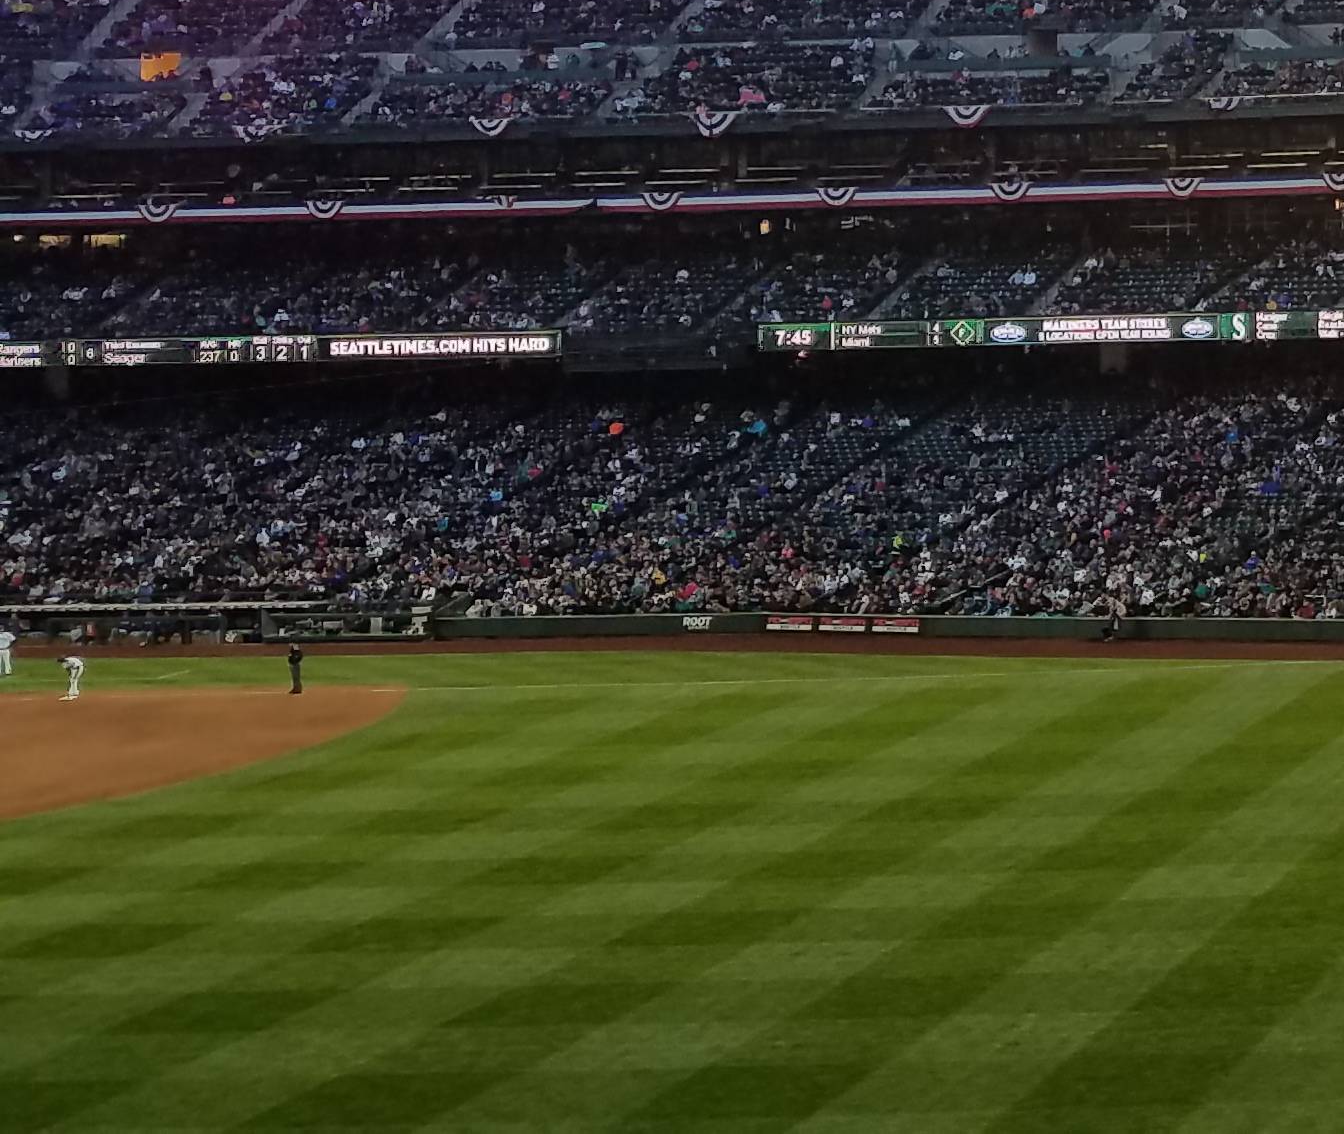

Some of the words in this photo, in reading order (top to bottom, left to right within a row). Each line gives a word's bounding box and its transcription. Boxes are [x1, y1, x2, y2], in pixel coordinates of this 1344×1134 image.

[775, 329, 813, 346] 7:45
[842, 325, 857, 335] NY
[255, 346, 265, 361] 3
[276, 346, 287, 361] 2
[301, 345, 308, 360] 1
[473, 337, 506, 353] HITS
[508, 337, 549, 352] HARD
[682, 616, 712, 627] ROOT
